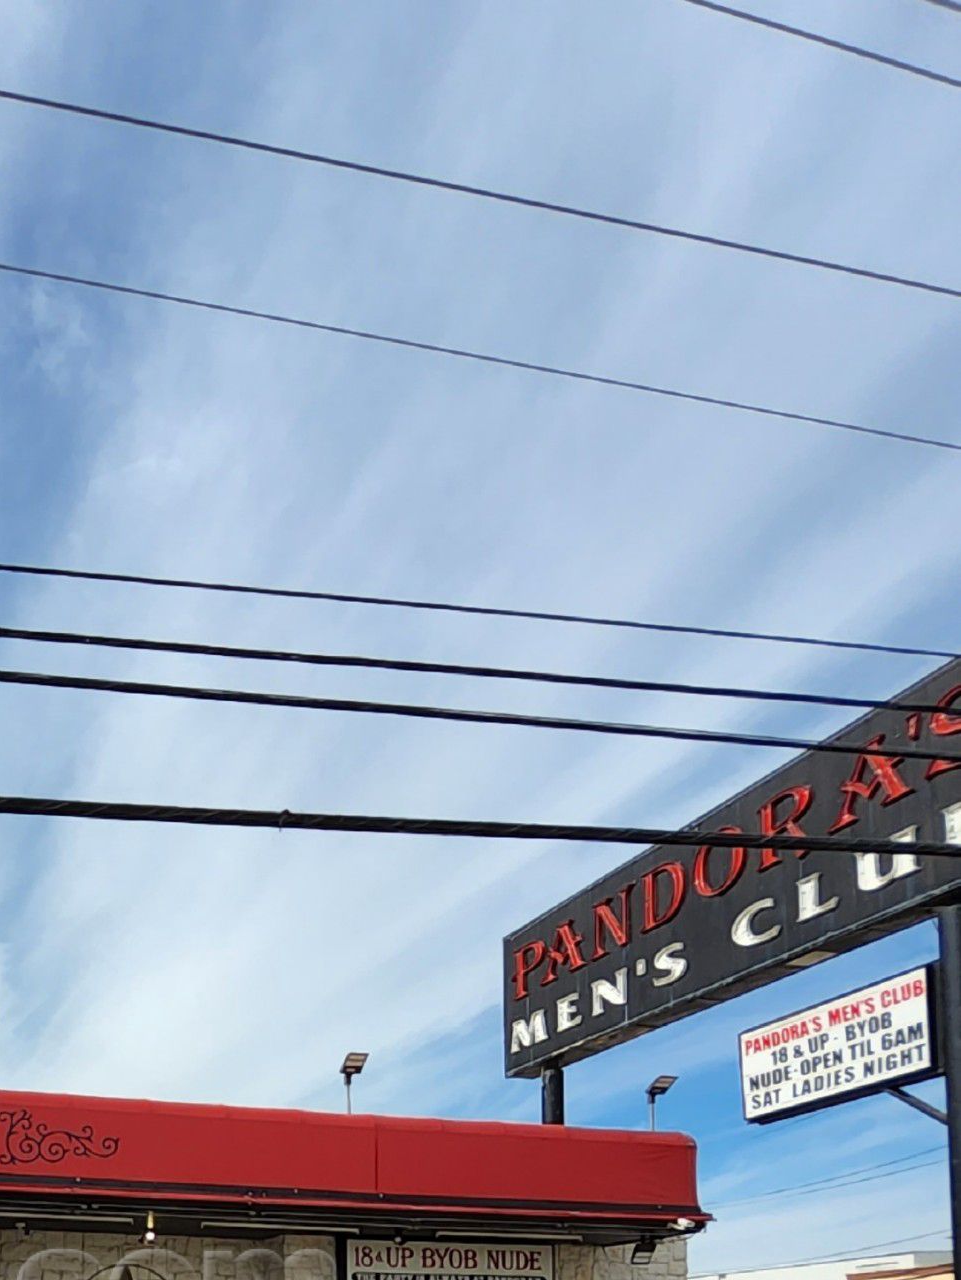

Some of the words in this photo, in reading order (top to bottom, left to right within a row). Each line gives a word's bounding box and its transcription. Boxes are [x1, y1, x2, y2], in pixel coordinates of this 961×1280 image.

[510, 942, 689, 1054] MEN'S
[731, 800, 961, 948] CLU
[745, 1016, 823, 1056] PANDORA'S
[828, 998, 876, 1027] MEN'S
[880, 979, 925, 1009] CLUB
[771, 1046, 789, 1066] 18
[793, 1044, 805, 1059] &
[808, 1033, 830, 1054] UP
[845, 1012, 893, 1043] BYOB
[848, 1042, 875, 1062] TIL
[881, 1022, 925, 1051] 6AM
[752, 1088, 782, 1110] SAT
[792, 1066, 856, 1098] LADIES
[863, 1043, 927, 1078] NIGHT
[422, 1246, 478, 1269] BYOB
[487, 1249, 542, 1271] NUDE
